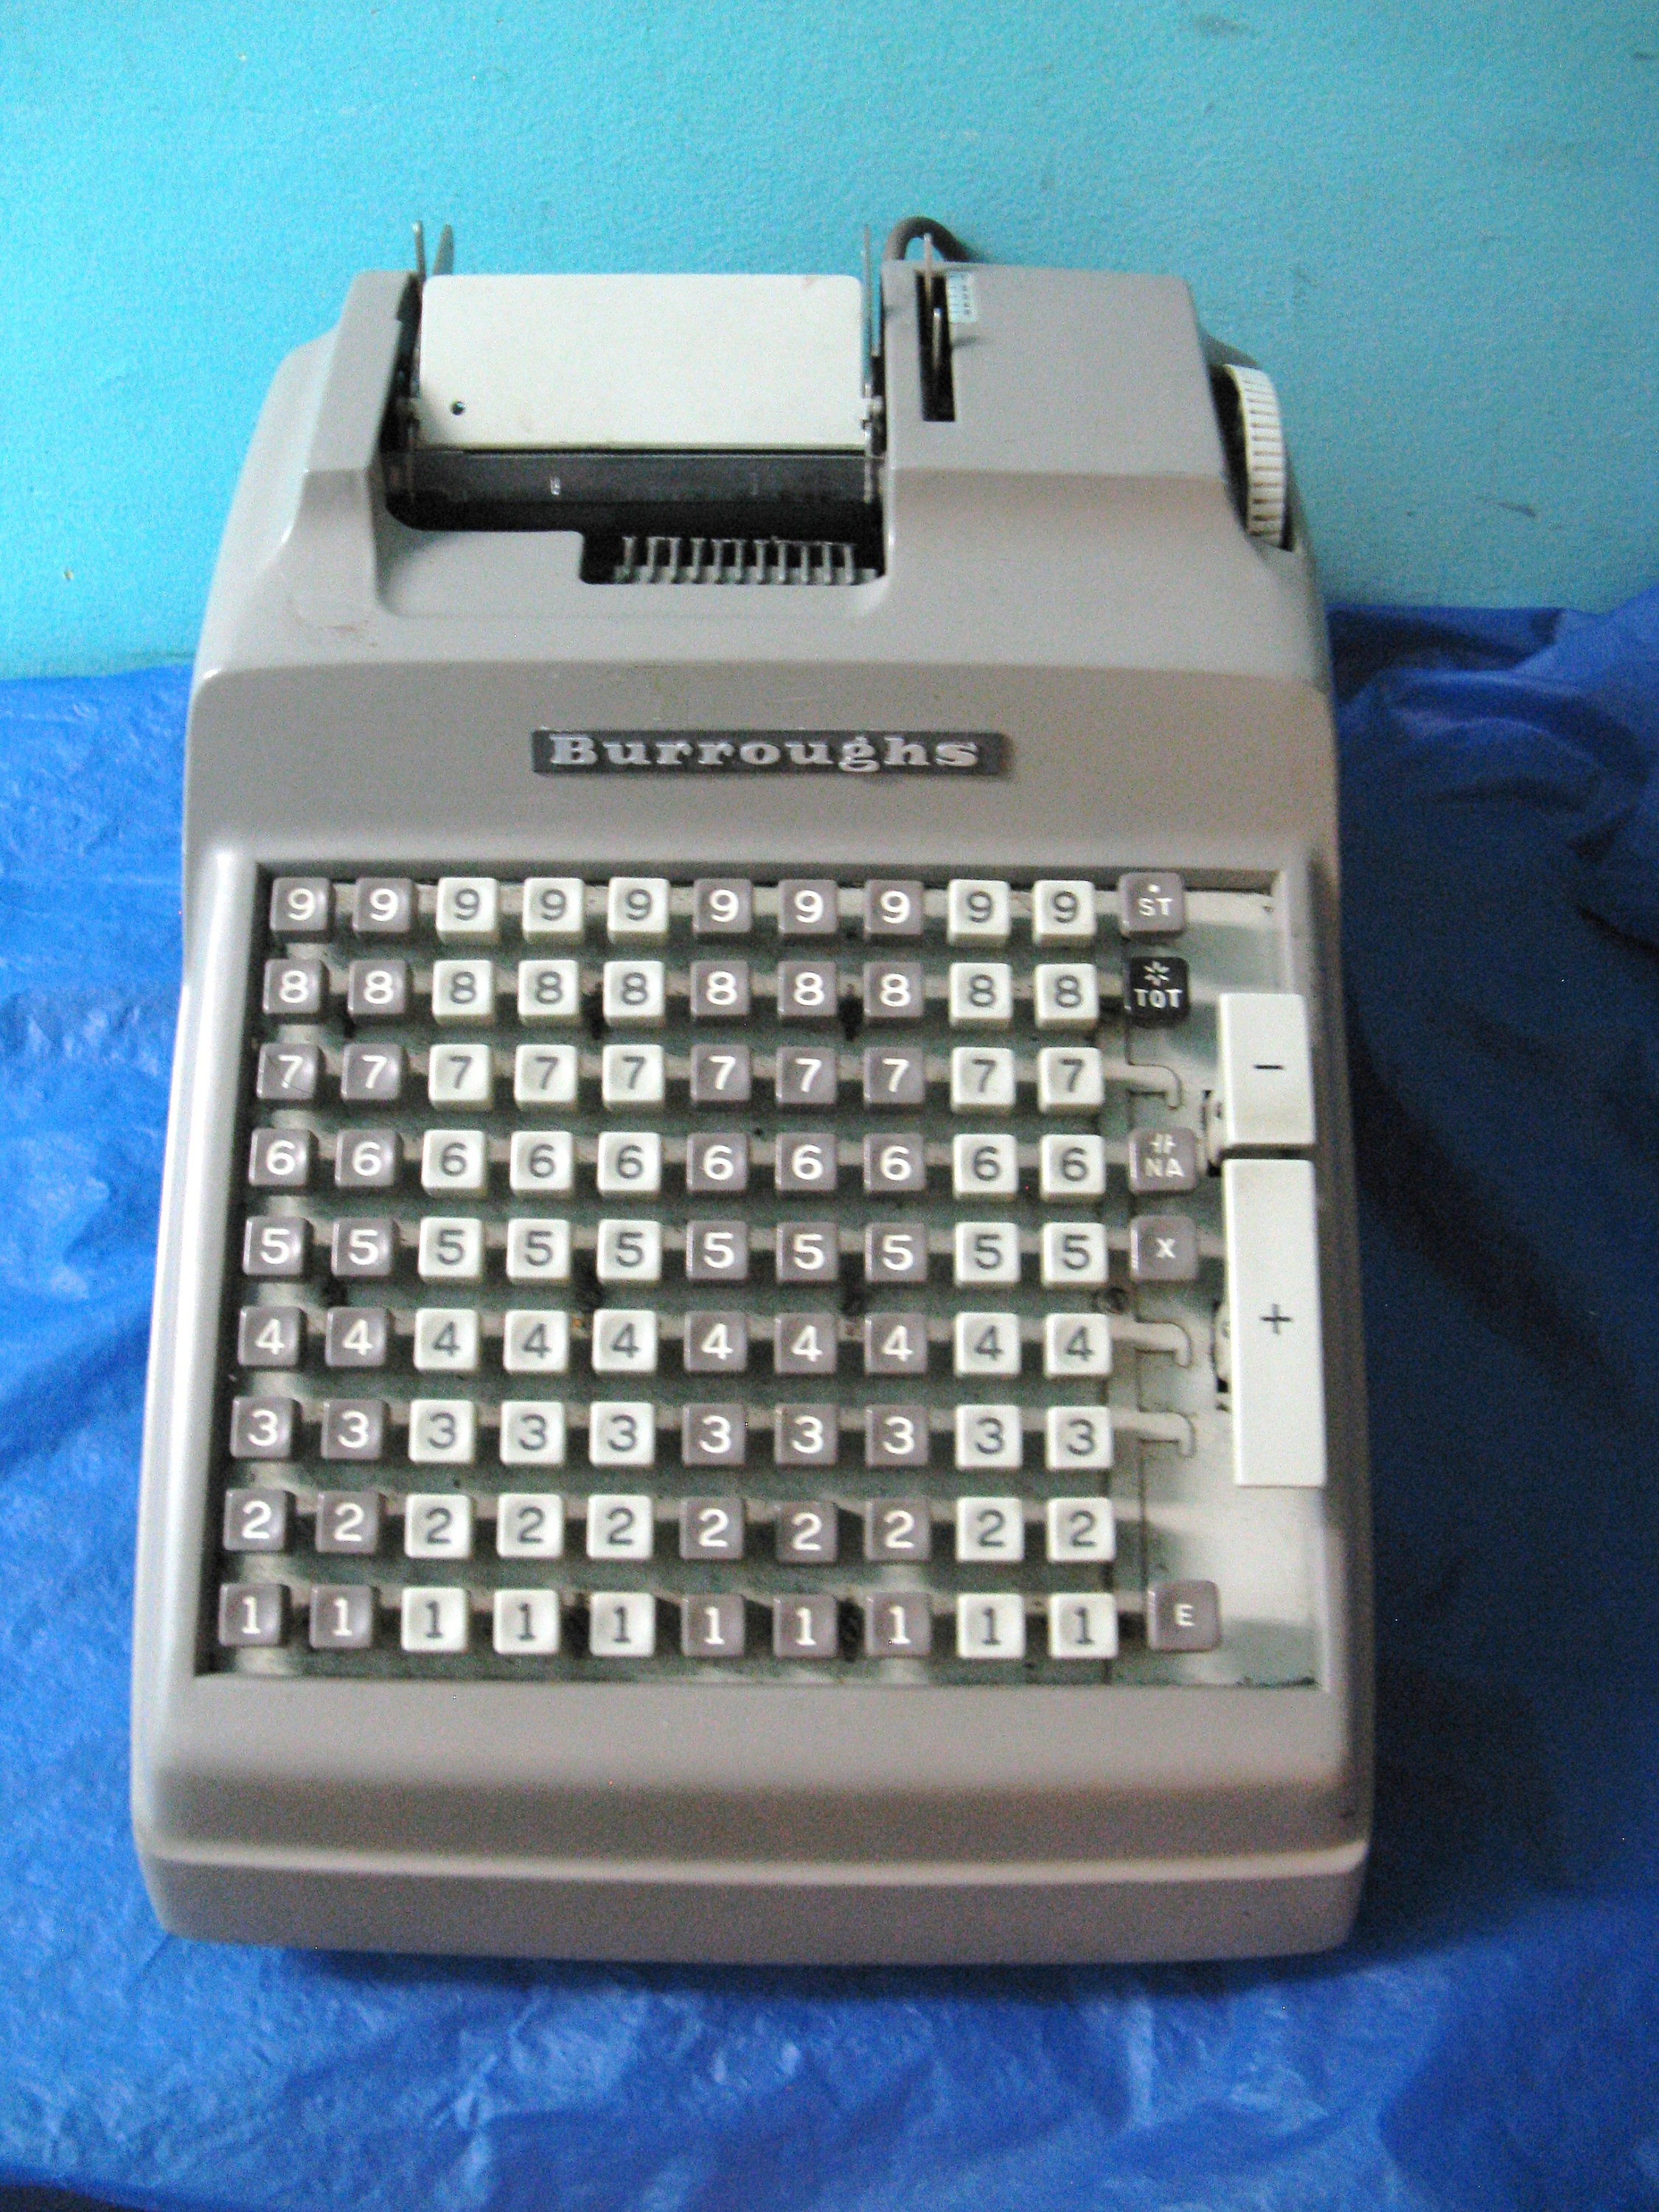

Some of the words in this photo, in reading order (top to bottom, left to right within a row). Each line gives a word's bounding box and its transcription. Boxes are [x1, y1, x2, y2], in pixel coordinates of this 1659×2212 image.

[549, 733, 979, 773] Burroughs
[288, 888, 316, 922] 9
[370, 888, 398, 922] 9
[453, 888, 481, 921] 9
[539, 889, 567, 922] 9
[625, 889, 653, 922] 9
[710, 889, 739, 922] 9
[795, 890, 824, 923] 9
[881, 890, 911, 924] 9
[966, 891, 994, 924] 9
[1051, 891, 1079, 925] 9
[1138, 897, 1174, 917] ST
[279, 970, 310, 1004] 8
[364, 970, 394, 1005] 8
[449, 970, 476, 1004] 8
[534, 970, 563, 1004] 8
[620, 971, 648, 1005] 8
[706, 971, 737, 1006] 8
[794, 972, 824, 1006] 8
[880, 973, 911, 1007] 8
[968, 973, 995, 1007] 8
[1054, 974, 1082, 1008] 8
[1134, 987, 1183, 1009] TOT
[279, 1054, 303, 1090] 7
[362, 1054, 387, 1090] 7
[447, 1054, 473, 1088] 7
[534, 1054, 560, 1089] 7
[622, 1054, 646, 1089] 7
[710, 1055, 736, 1091] 7
[796, 1058, 821, 1093] 7
[883, 1058, 909, 1093] 7
[971, 1057, 997, 1092] 7
[1058, 1057, 1085, 1092] 7
[266, 1140, 296, 1176] 6
[352, 1141, 383, 1177] 6
[439, 1141, 466, 1176] 6
[528, 1143, 554, 1178] 6
[616, 1144, 643, 1179] 6
[703, 1144, 734, 1180] 6
[792, 1144, 823, 1180] 6
[880, 1146, 911, 1181] 6
[972, 1145, 1001, 1181] 6
[1060, 1146, 1088, 1182] 6
[1145, 1157, 1185, 1178] NA
[260, 1228, 291, 1266] 5
[349, 1228, 379, 1266] 5
[437, 1228, 464, 1265] 5
[525, 1229, 552, 1266] 5
[616, 1230, 644, 1267] 5
[704, 1231, 734, 1269] 5
[794, 1234, 824, 1270] 5
[883, 1234, 914, 1271] 5
[974, 1233, 1002, 1270] 5
[1062, 1234, 1091, 1271] 5
[255, 1318, 285, 1355] 4
[342, 1319, 372, 1356] 4
[432, 1321, 459, 1356] 4
[522, 1322, 550, 1358] 4
[611, 1322, 639, 1358] 4
[701, 1323, 733, 1360] 4
[792, 1325, 822, 1362] 4
[883, 1325, 913, 1361] 4
[974, 1326, 1003, 1360] 4
[1065, 1327, 1093, 1361] 4
[248, 1409, 278, 1447] 3
[338, 1411, 369, 1449] 3
[428, 1411, 456, 1450] 3
[518, 1413, 546, 1451] 3
[608, 1413, 636, 1453] 3
[700, 1415, 731, 1454] 3
[793, 1416, 824, 1454] 3
[884, 1416, 914, 1455] 3
[975, 1416, 1004, 1455] 3
[1066, 1418, 1096, 1457] 3
[242, 1500, 271, 1540] 2
[334, 1503, 364, 1542] 2
[426, 1506, 451, 1545] 2
[518, 1506, 544, 1544] 2
[608, 1506, 634, 1545] 2
[699, 1508, 728, 1548] 2
[793, 1512, 821, 1551] 2
[885, 1510, 914, 1548] 2
[977, 1509, 1005, 1548] 2
[1069, 1509, 1096, 1548] 2
[242, 1596, 261, 1635] 1
[333, 1598, 352, 1637] 1
[425, 1600, 442, 1639] 1
[518, 1602, 535, 1641] 1
[613, 1605, 630, 1644] 1
[705, 1607, 724, 1645] 1
[797, 1607, 815, 1646] 1
[891, 1606, 911, 1645] 1
[982, 1606, 1001, 1646] 1
[1075, 1606, 1093, 1646] 1
[1175, 1603, 1194, 1627] E
